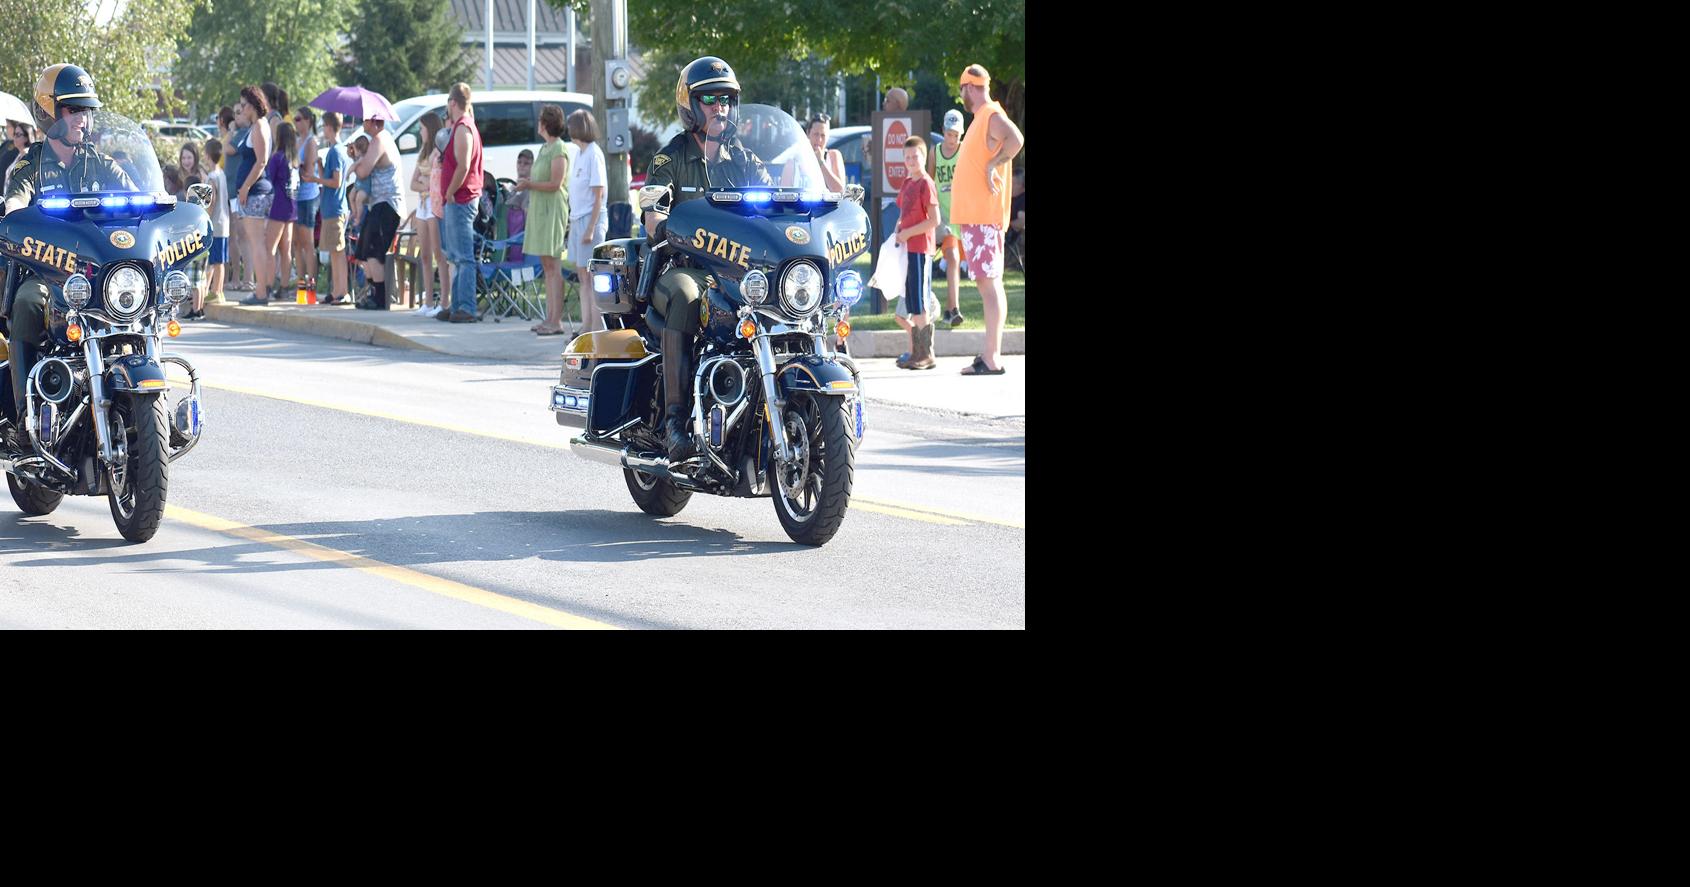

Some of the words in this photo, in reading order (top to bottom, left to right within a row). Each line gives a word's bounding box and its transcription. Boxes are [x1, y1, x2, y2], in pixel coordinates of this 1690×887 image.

[888, 133, 896, 145] DO
[896, 133, 907, 145] NOT
[888, 166, 906, 177] ENTER
[21, 236, 77, 274] STATE
[158, 229, 204, 271] POLICE
[692, 228, 752, 269] STATE
[828, 232, 867, 269] POLICE
